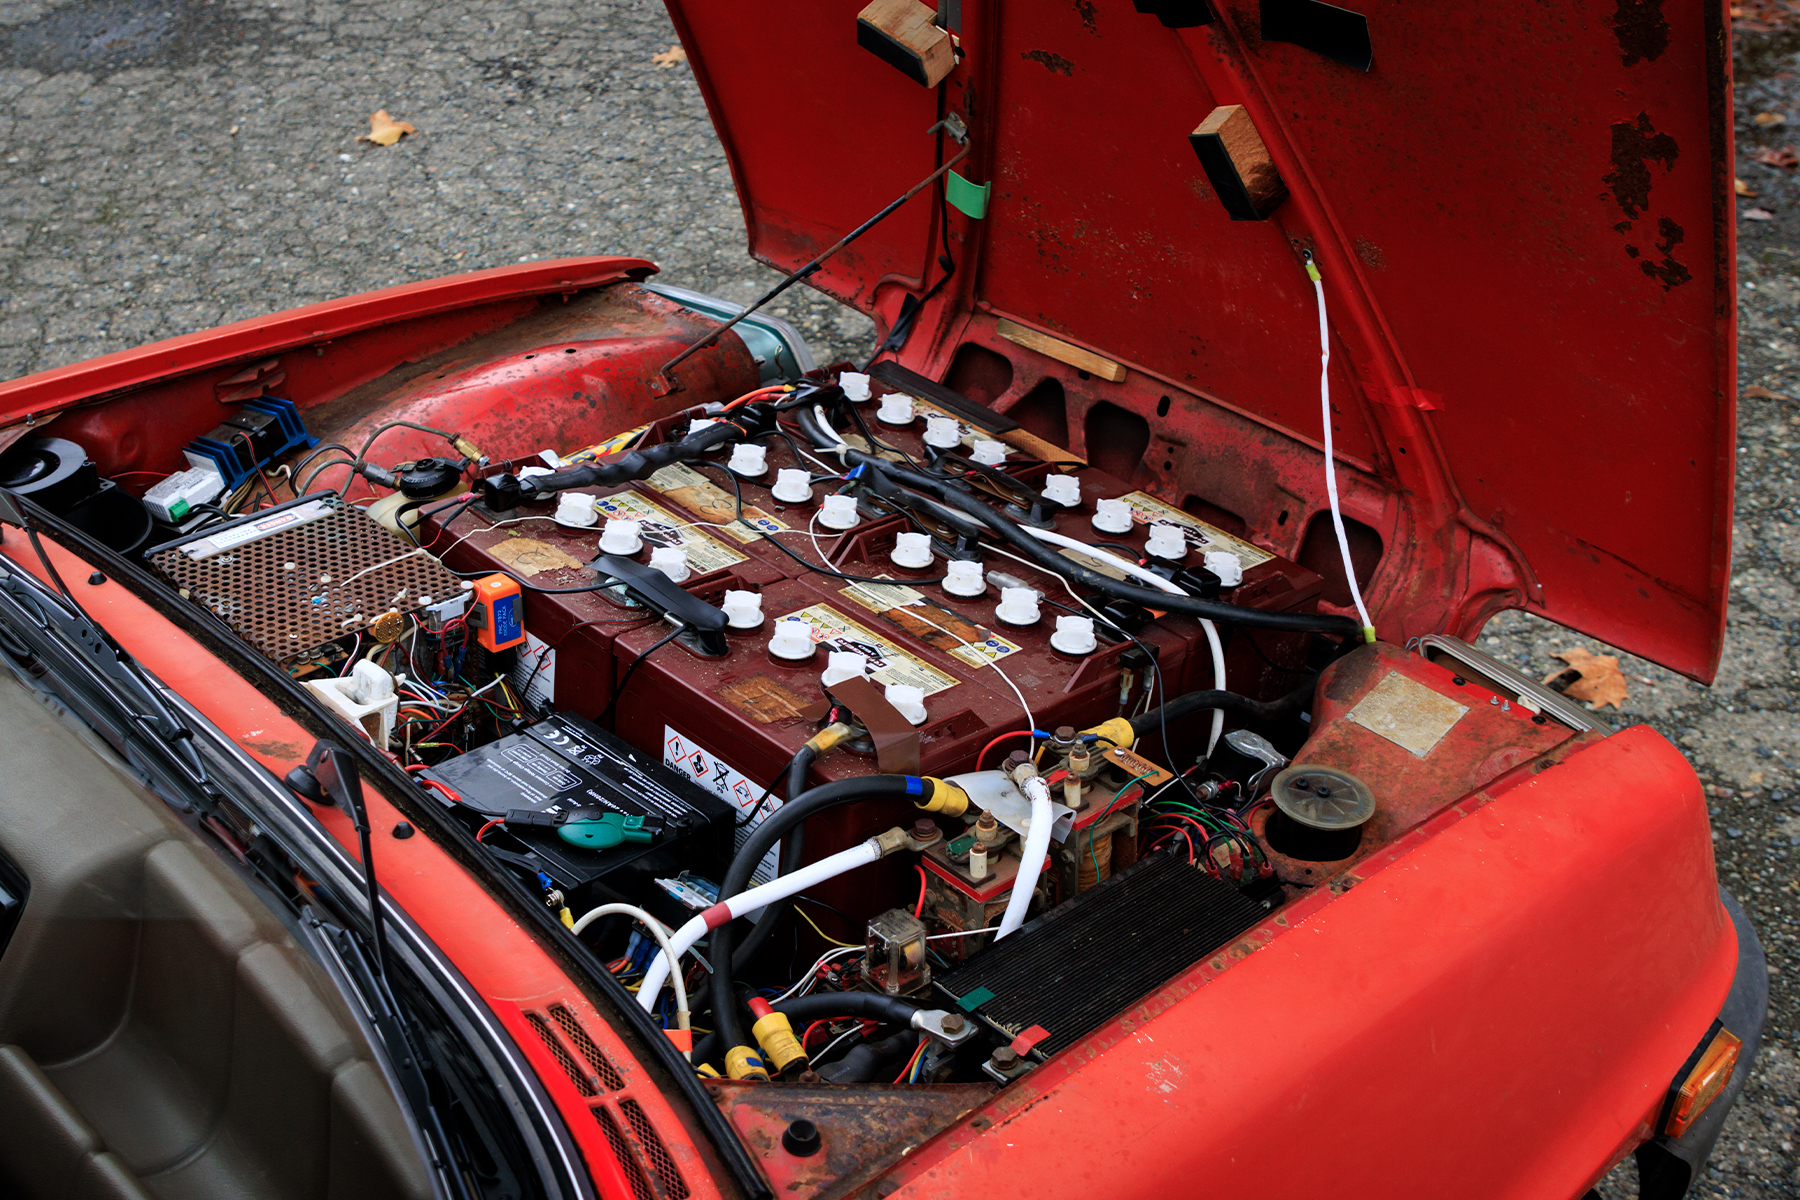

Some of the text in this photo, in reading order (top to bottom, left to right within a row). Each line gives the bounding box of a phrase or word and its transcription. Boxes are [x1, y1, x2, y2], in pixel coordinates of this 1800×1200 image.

[259, 514, 295, 530] DANGER
[640, 519, 684, 546] RANER
[664, 758, 692, 781] DANGER
